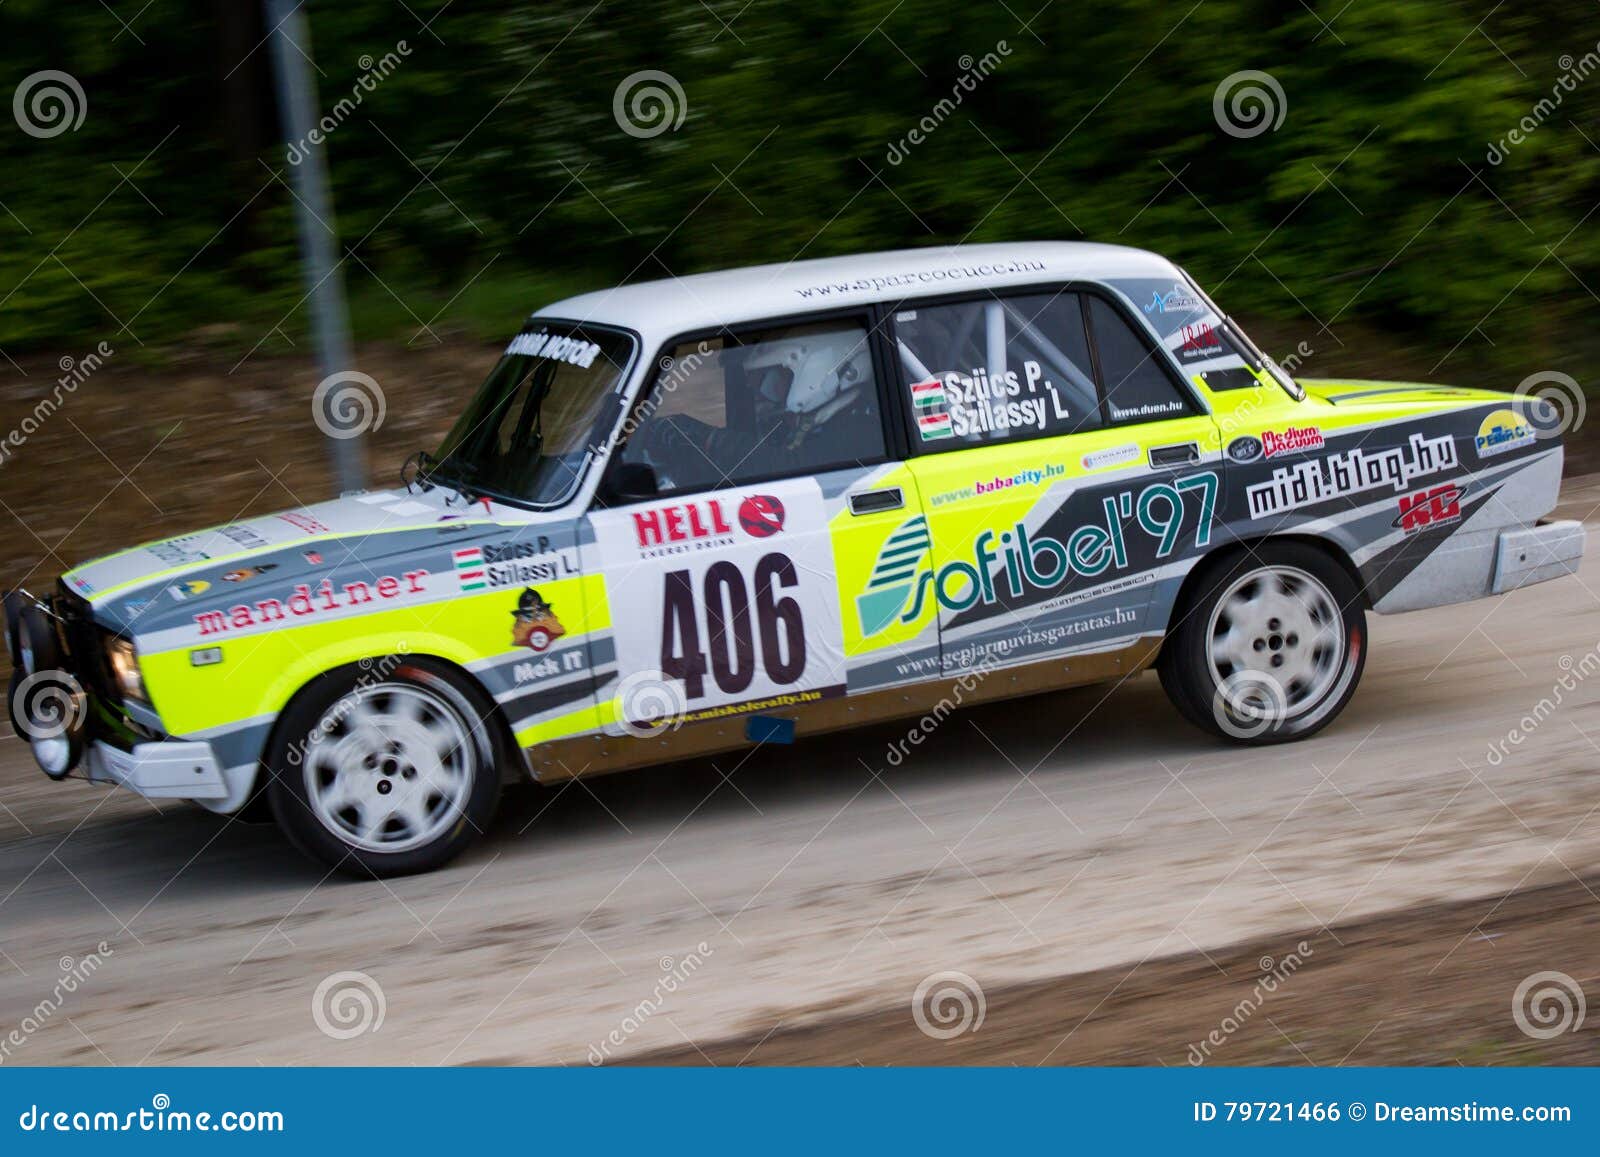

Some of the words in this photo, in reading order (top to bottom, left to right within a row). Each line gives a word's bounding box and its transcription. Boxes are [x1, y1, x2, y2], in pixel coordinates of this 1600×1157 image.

[949, 395, 1046, 438] Szilassy
[1050, 388, 1069, 420] L
[1111, 400, 1183, 420] www.duen.hu
[931, 463, 1065, 506] www.babacity.hu
[632, 499, 732, 547] HELL
[697, 537, 735, 550] DRINK
[488, 561, 558, 587] Szilassy
[194, 568, 432, 636] mandiner
[660, 552, 807, 699] 406
